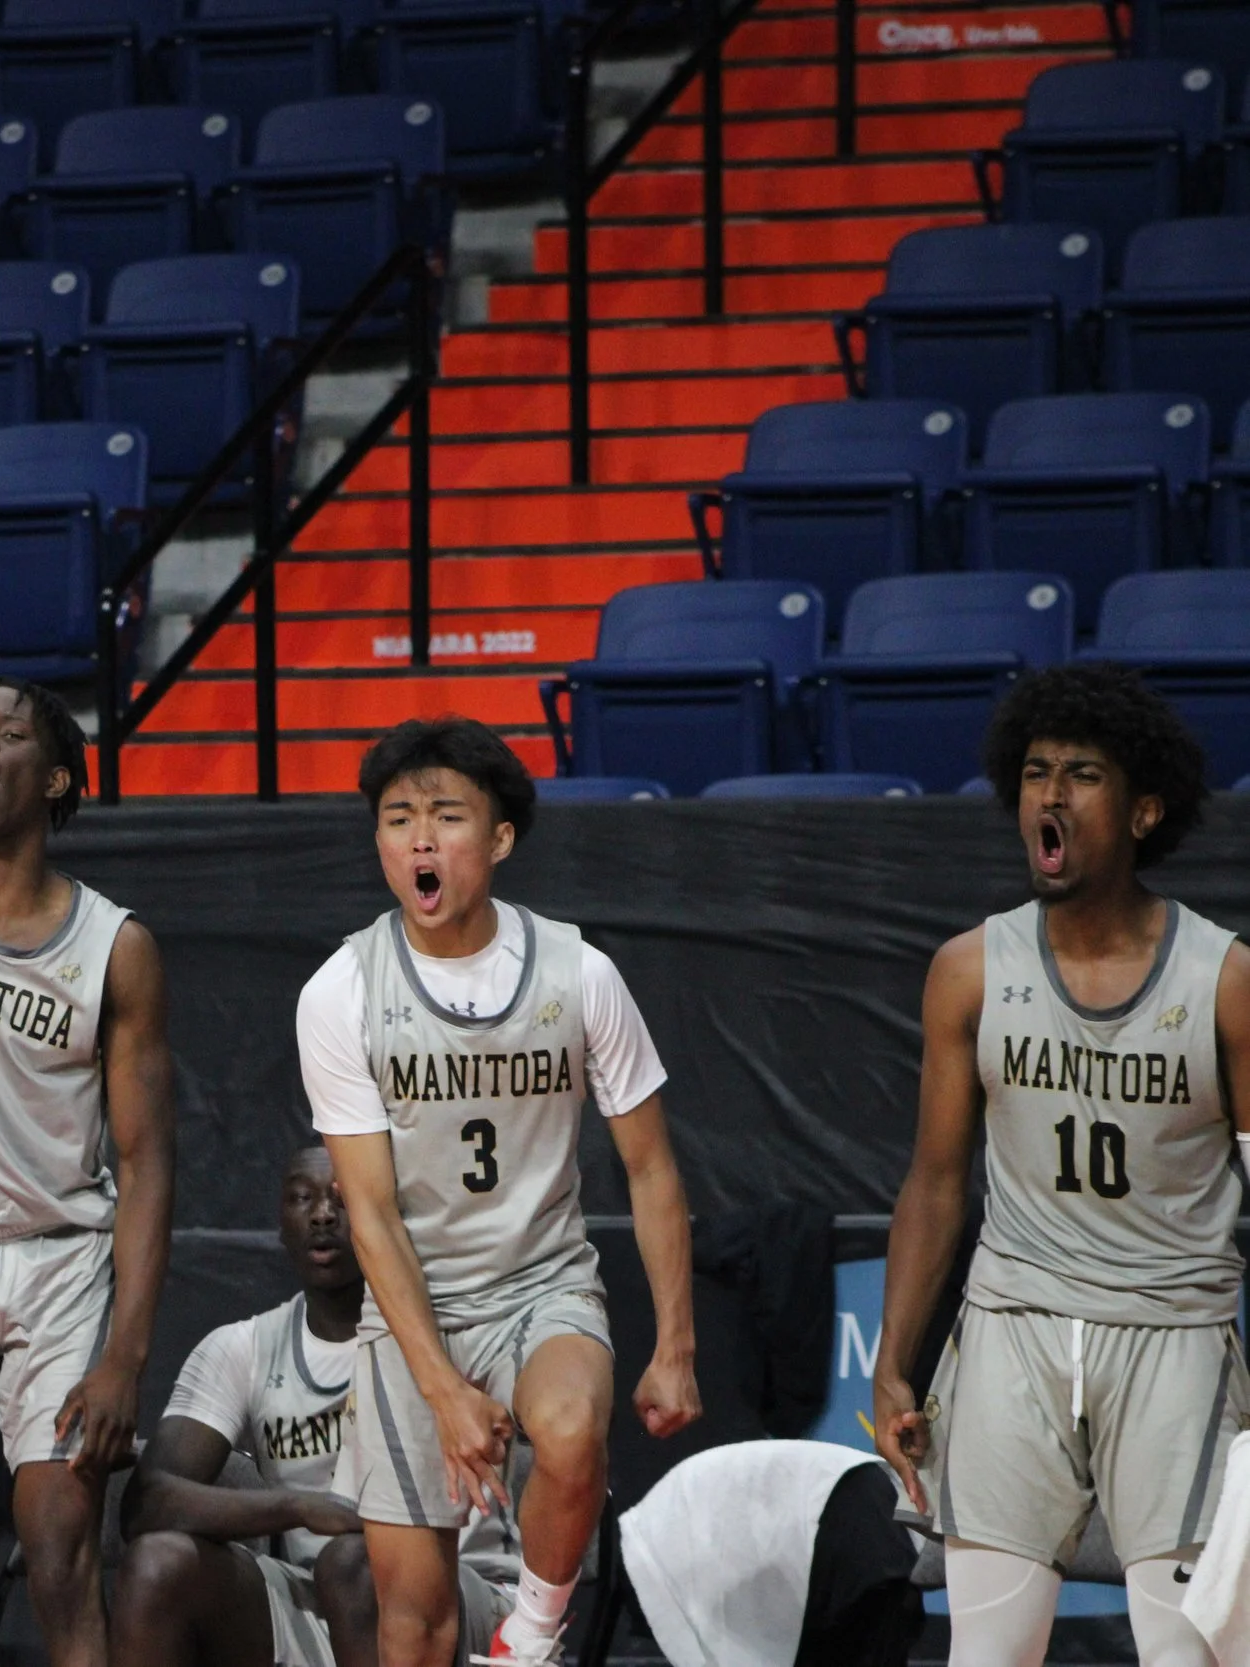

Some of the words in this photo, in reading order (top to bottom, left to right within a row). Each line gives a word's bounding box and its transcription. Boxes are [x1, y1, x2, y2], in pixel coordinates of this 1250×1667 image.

[373, 633, 478, 658] NIAARA
[390, 1047, 572, 1101] MANITOBA
[1003, 1036, 1191, 1104] MANITOBA
[461, 1118, 498, 1193] 3
[1055, 1114, 1130, 1199] 10
